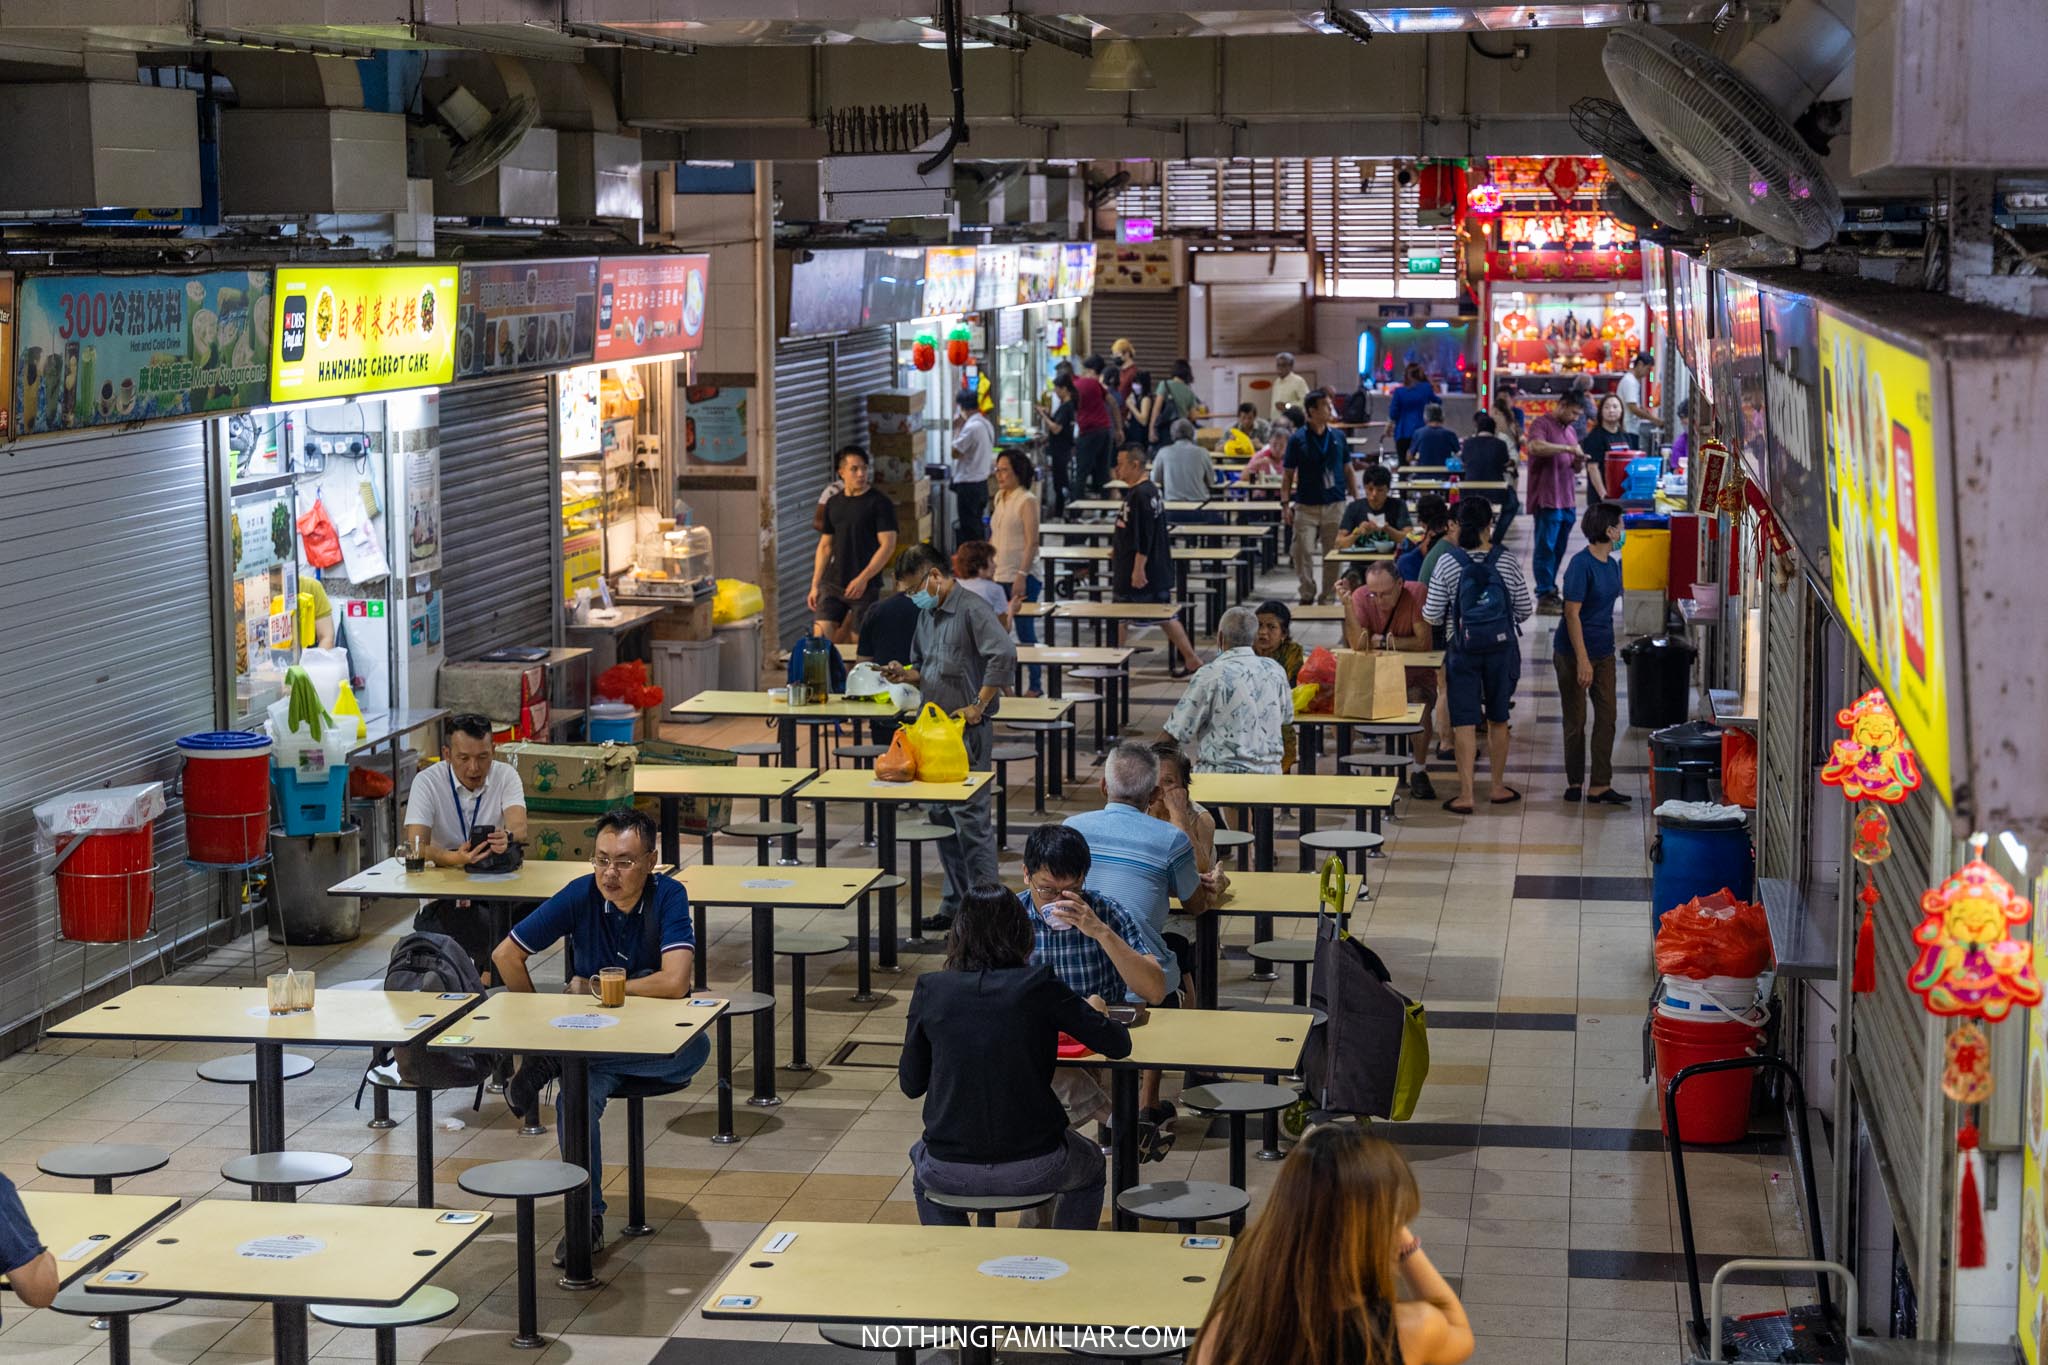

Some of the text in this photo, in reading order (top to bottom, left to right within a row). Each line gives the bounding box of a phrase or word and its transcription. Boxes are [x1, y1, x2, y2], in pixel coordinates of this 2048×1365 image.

[59, 288, 182, 339] 300 冷热饮料
[290, 312, 305, 329] DBS
[129, 338, 181, 352] Hot and Cold Drink
[192, 366, 219, 389] Muar
[219, 363, 268, 390] Sugarcane
[318, 353, 429, 382] HANDMADE CARROT CAKE
